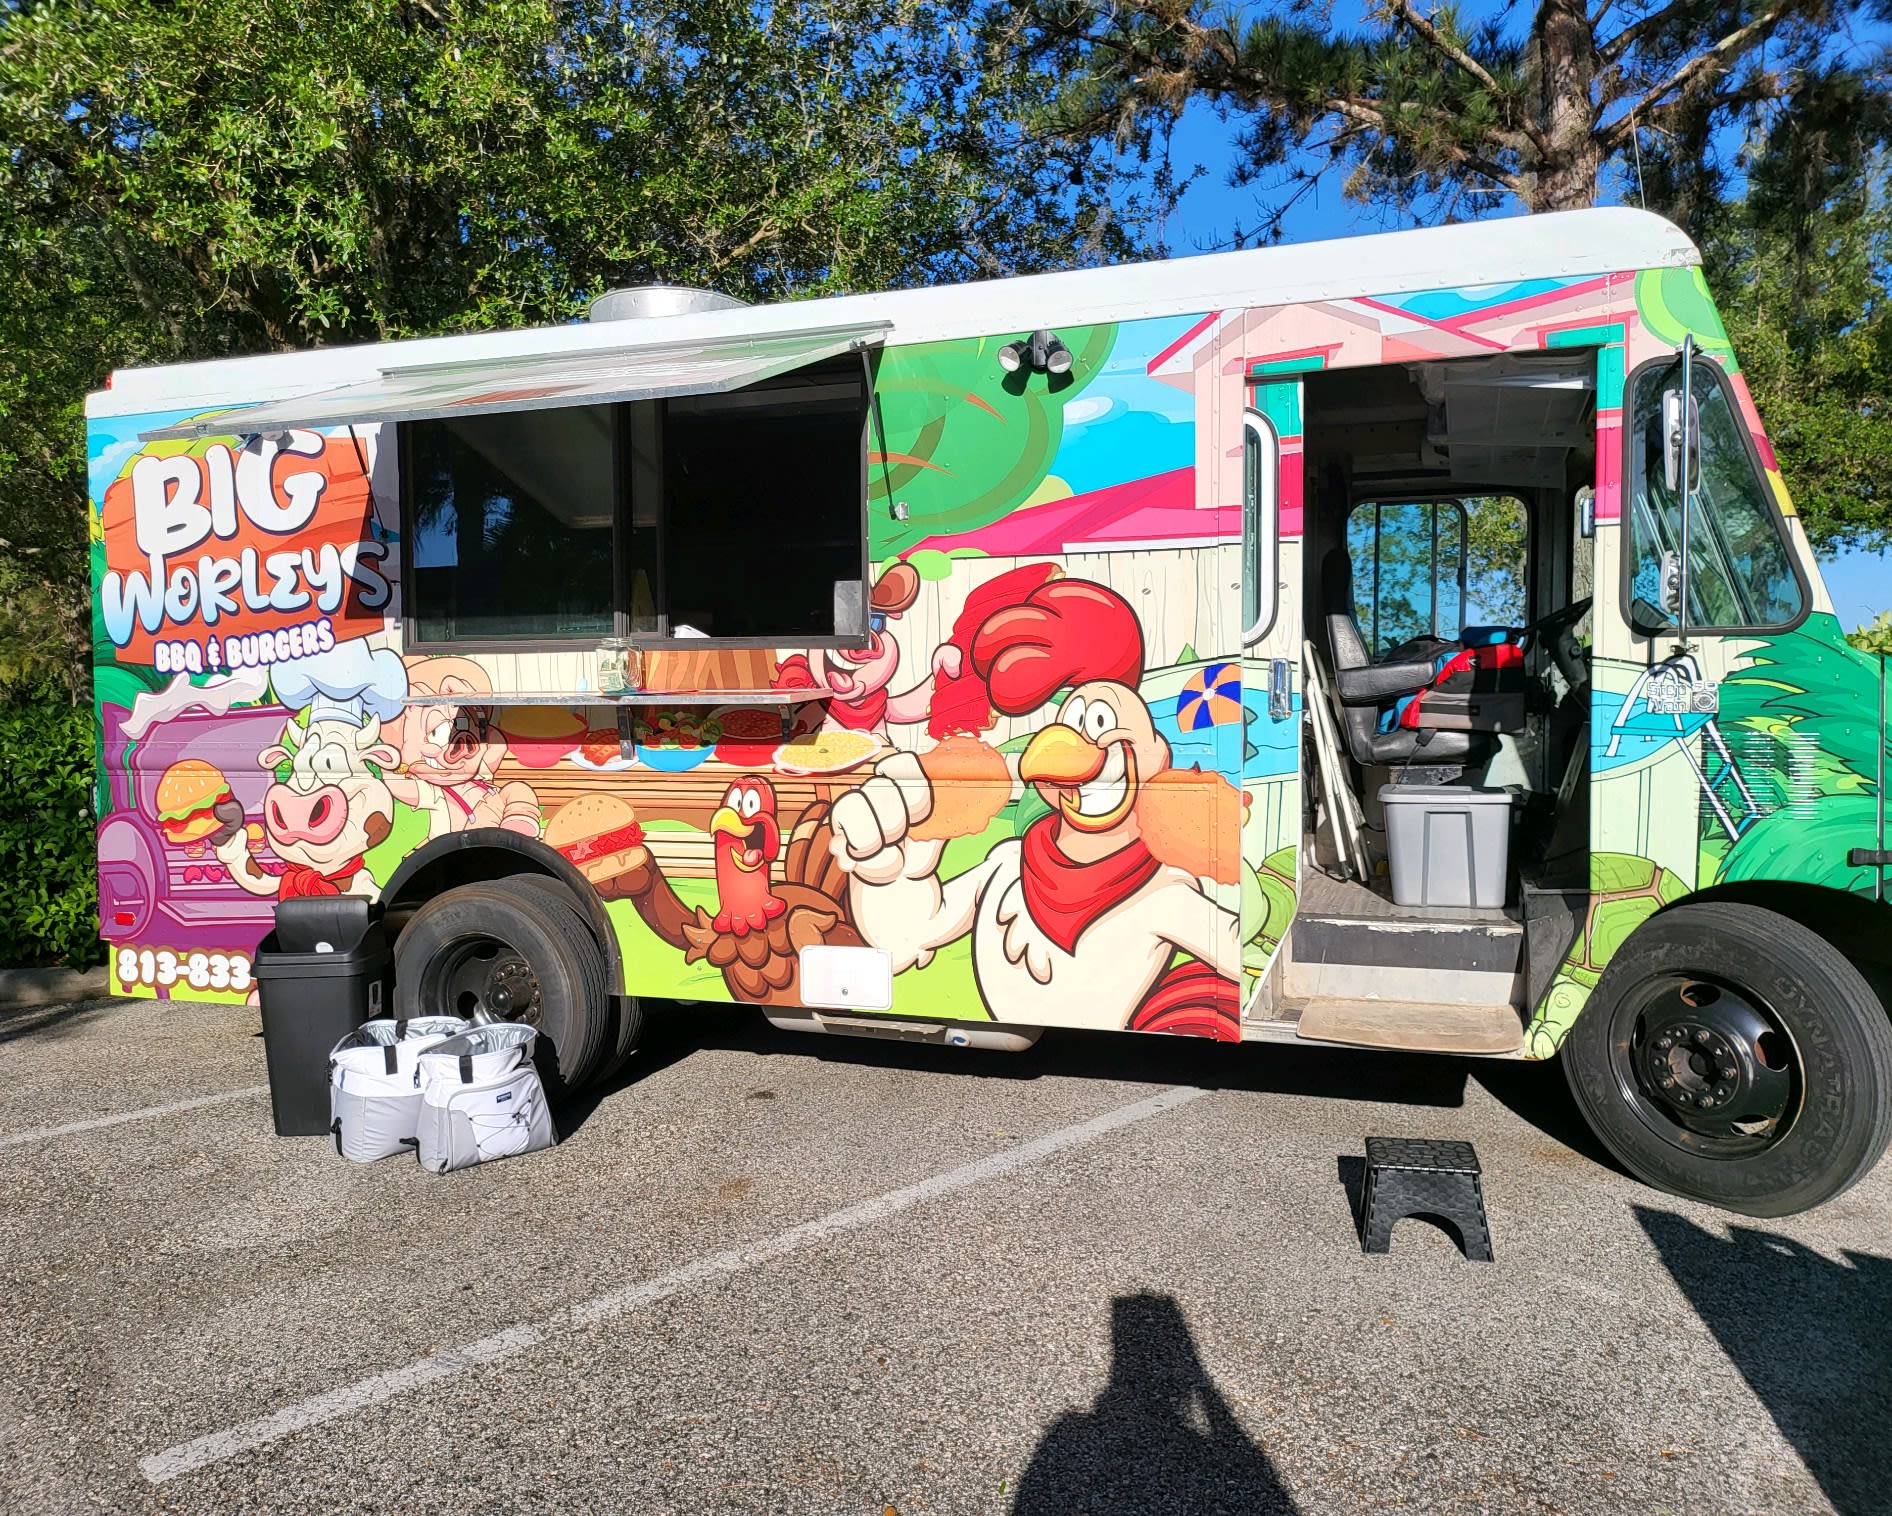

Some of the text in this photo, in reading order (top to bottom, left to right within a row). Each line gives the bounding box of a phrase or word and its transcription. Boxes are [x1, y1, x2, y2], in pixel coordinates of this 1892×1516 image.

[131, 428, 326, 556] BIG
[154, 617, 335, 674] BBQ & BURGERS
[1647, 681, 1687, 700] Step
[1648, 697, 1690, 714] Van
